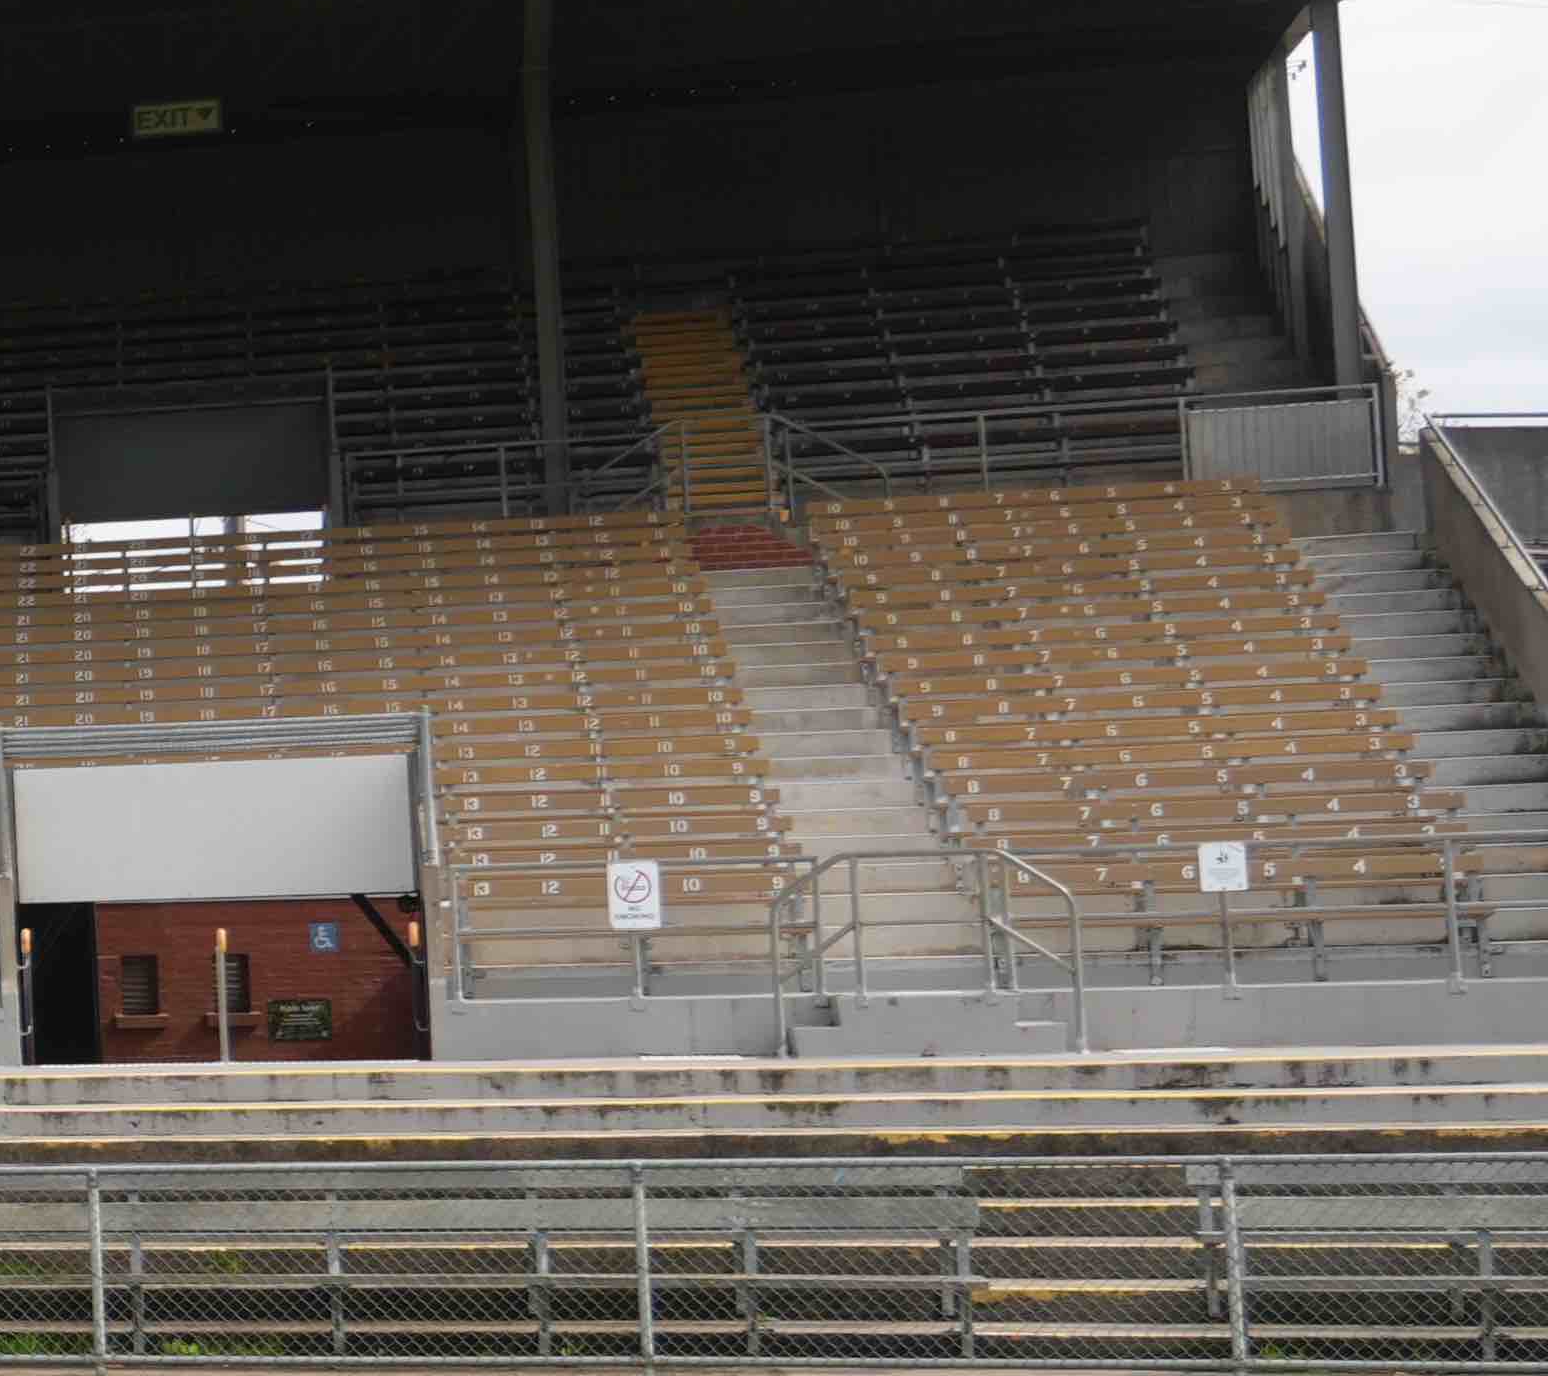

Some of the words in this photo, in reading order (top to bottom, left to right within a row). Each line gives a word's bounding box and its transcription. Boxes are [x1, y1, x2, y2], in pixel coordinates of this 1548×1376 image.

[138, 108, 194, 130] EXIT
[15, 694, 30, 706] 21
[75, 691, 94, 704] 20
[259, 683, 276, 696] 17
[1025, 727, 1036, 740] 7
[1188, 720, 1201, 734] 5
[1271, 717, 1283, 730] 4
[1355, 713, 1367, 726] 3
[1036, 753, 1048, 766] 7
[1284, 741, 1297, 754] 4
[1369, 737, 1381, 750] 3
[1059, 776, 1073, 790] 7
[1217, 768, 1229, 783] 5
[1301, 767, 1314, 781] 4
[1395, 763, 1407, 778] 3
[464, 797, 480, 811] 13
[531, 794, 549, 808] 12
[600, 792, 612, 807] 11
[668, 791, 685, 805] 10
[749, 789, 762, 803] 9
[1079, 806, 1091, 820] 7
[1237, 800, 1250, 815] 5
[1326, 798, 1341, 812] 4
[1407, 794, 1421, 809] 3
[467, 826, 483, 841] 13
[542, 823, 558, 838] 12
[599, 823, 610, 836] 11
[670, 819, 688, 833] 10
[756, 817, 769, 831] 9
[1087, 835, 1100, 847] 7
[1346, 826, 1361, 839] 4
[1095, 867, 1109, 881] 7
[1264, 862, 1277, 876] 5
[1353, 859, 1366, 874] 4
[542, 880, 560, 894] 12
[683, 877, 701, 892] 10
[772, 876, 785, 890] 9
